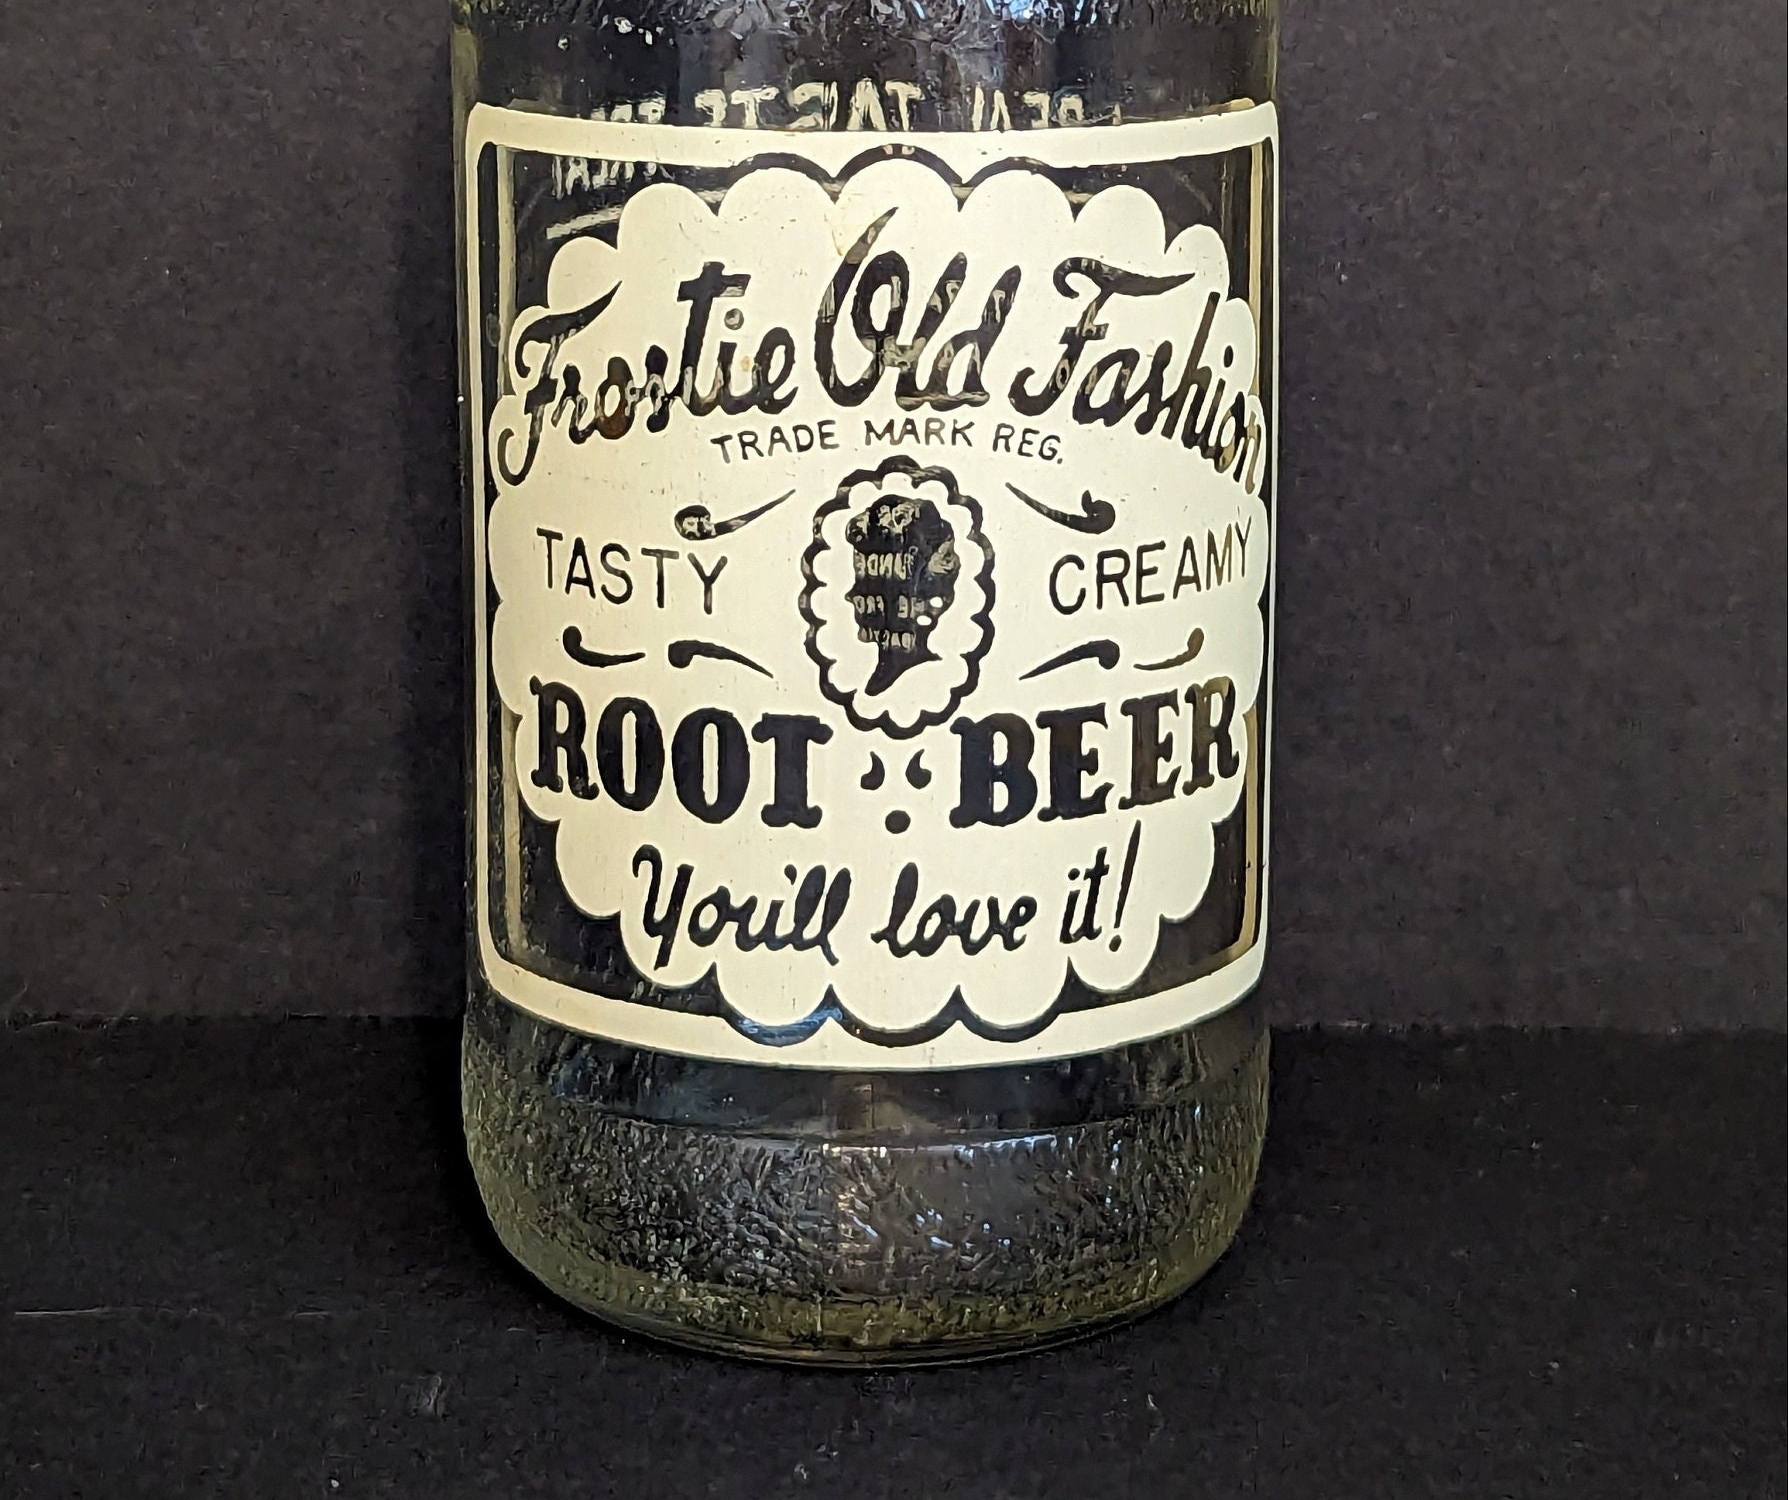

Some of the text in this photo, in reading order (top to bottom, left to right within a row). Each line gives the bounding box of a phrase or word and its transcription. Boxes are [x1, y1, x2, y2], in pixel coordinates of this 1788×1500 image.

[498, 206, 1262, 495] Frostie Old Fashion
[710, 417, 1063, 464] TRADE MARK REG.
[536, 526, 729, 615] TASTY
[1048, 516, 1253, 615] CREAMY
[529, 675, 1241, 829] ROOT BEER
[632, 819, 1142, 971] You'll love it!
